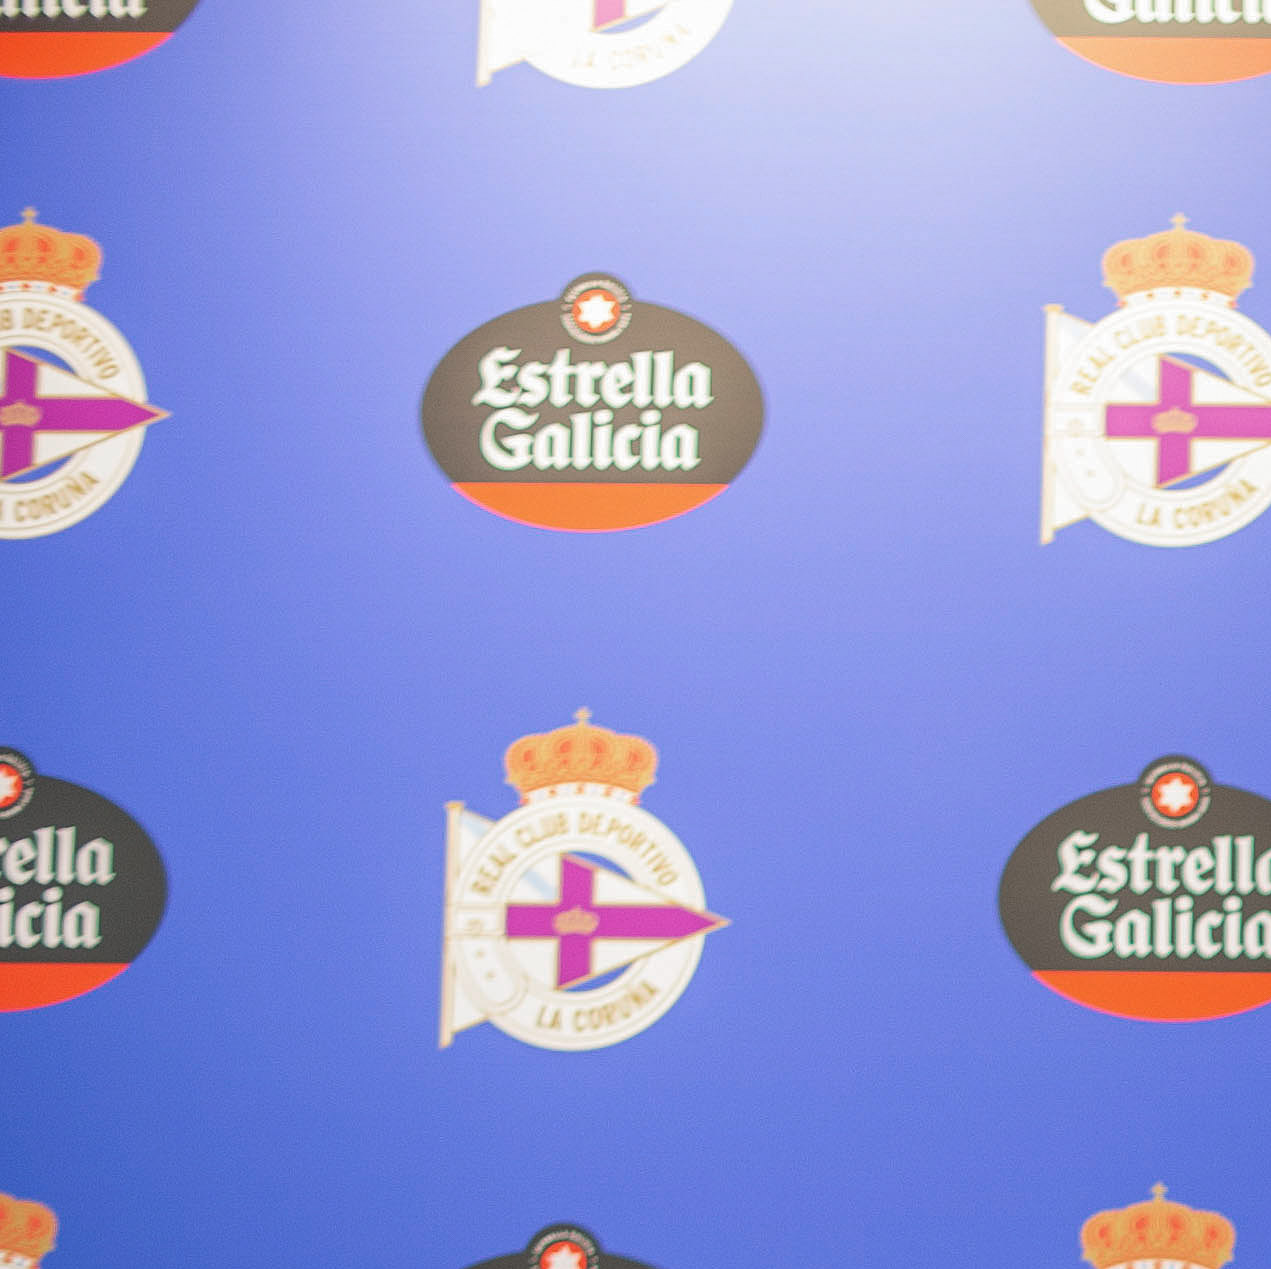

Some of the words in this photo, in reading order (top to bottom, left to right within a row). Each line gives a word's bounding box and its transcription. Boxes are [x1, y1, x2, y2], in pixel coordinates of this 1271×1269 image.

[474, 347, 710, 407] Estrella
[482, 409, 698, 469] Galicia
[0, 825, 116, 885] ella
